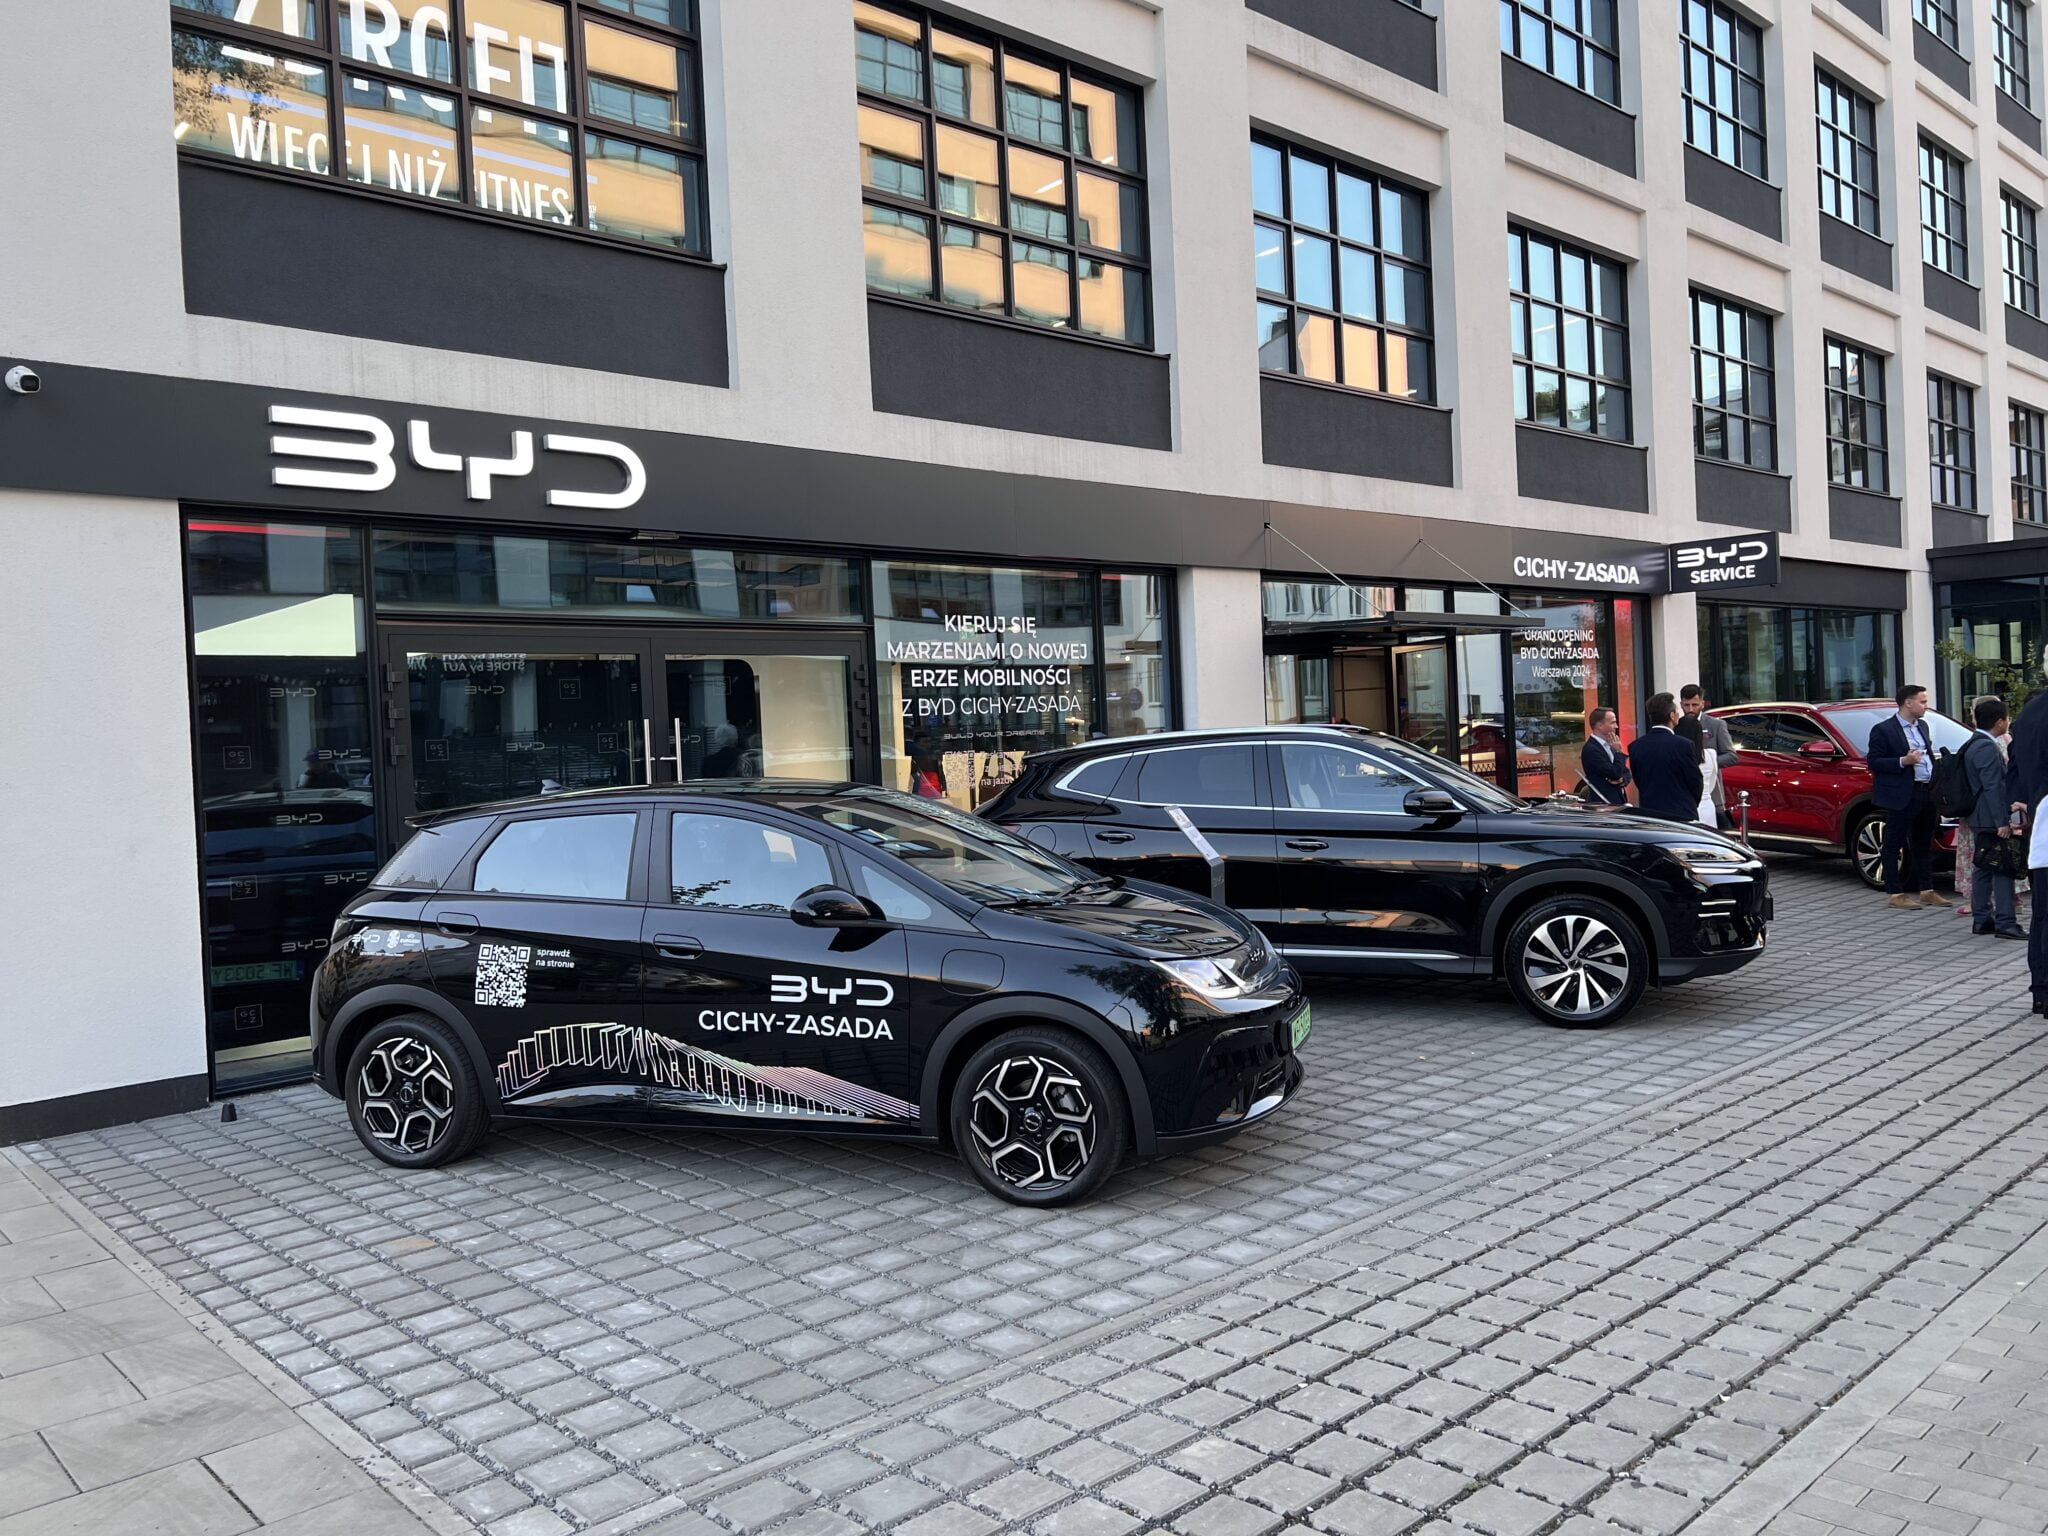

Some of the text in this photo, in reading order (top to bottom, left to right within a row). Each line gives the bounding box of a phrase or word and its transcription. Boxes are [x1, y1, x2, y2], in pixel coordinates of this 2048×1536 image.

[388, 149, 448, 200] NIŻ
[268, 405, 647, 509] BYD
[1677, 541, 1768, 568] BYD
[1513, 556, 1640, 584] CICHY-ZASADA
[1690, 565, 1756, 584] SERVICE
[945, 615, 1037, 638] KIERUJ SIĘ
[1557, 630, 1594, 642] OPENING
[887, 641, 1088, 660] MARZENIAMI O NOWEJ
[1520, 647, 1600, 660] BYD CICHY-ZASADA
[911, 665, 1071, 688] ERZE MOBILNOŚCI
[1531, 665, 1591, 677] Warszawa 2024
[902, 695, 1082, 717] Z BYD CICHY-ZASADA
[276, 813, 323, 825] BYD
[281, 938, 329, 953] BYD
[537, 949, 571, 958] sprawdź
[546, 960, 575, 969] stronie
[770, 974, 894, 1007] BYD
[698, 1010, 894, 1041] CICHY-ZASADA
